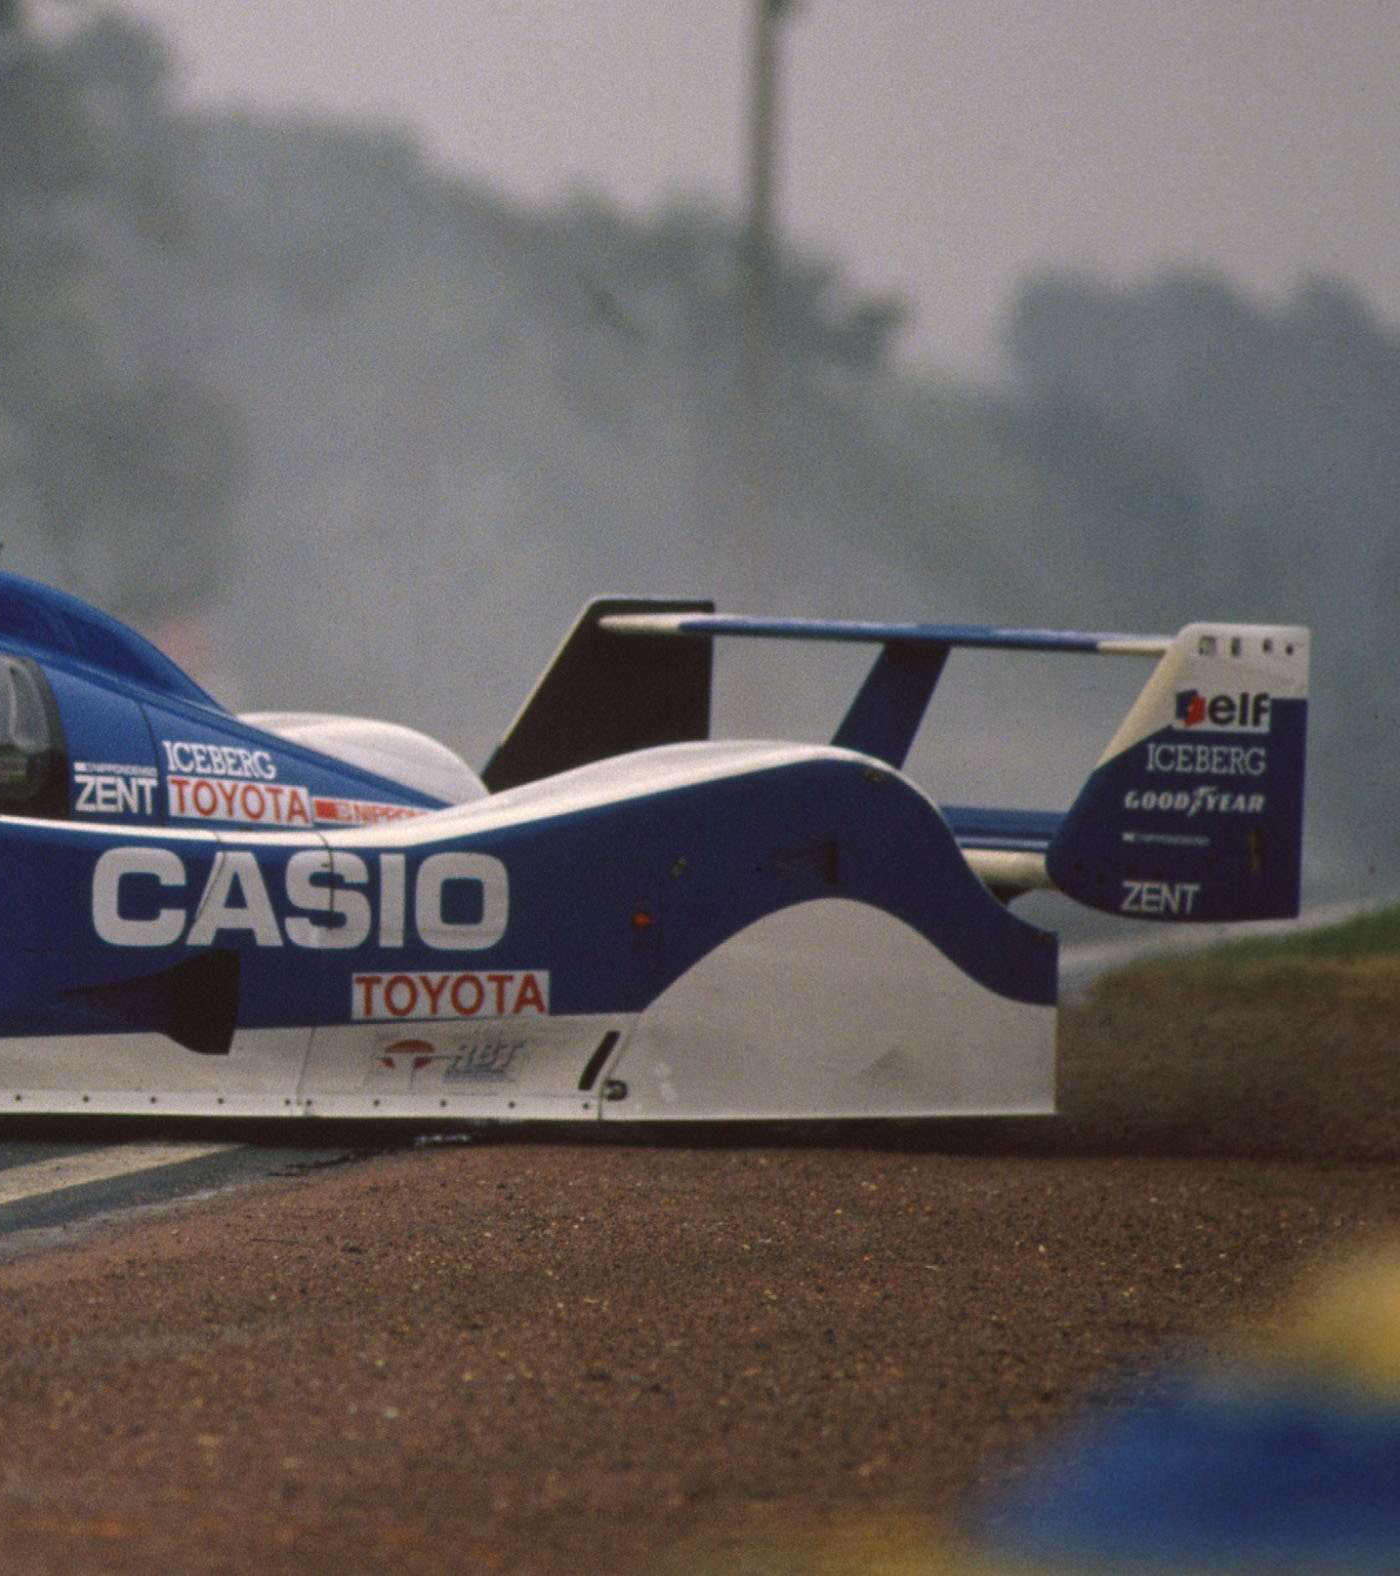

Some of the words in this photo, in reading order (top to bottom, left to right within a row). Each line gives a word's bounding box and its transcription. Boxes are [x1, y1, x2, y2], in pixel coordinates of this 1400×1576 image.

[1207, 692, 1270, 726] elf
[162, 741, 277, 781] ICEBERG
[1146, 745, 1266, 775] ICEBERG
[74, 775, 158, 814] ZENT
[170, 778, 309, 824] TOYOTA
[1124, 785, 1265, 817] GOODYEAR
[91, 847, 510, 951] CASIO
[1121, 880, 1199, 913] ZENT
[355, 973, 547, 1017] TOYOTA
